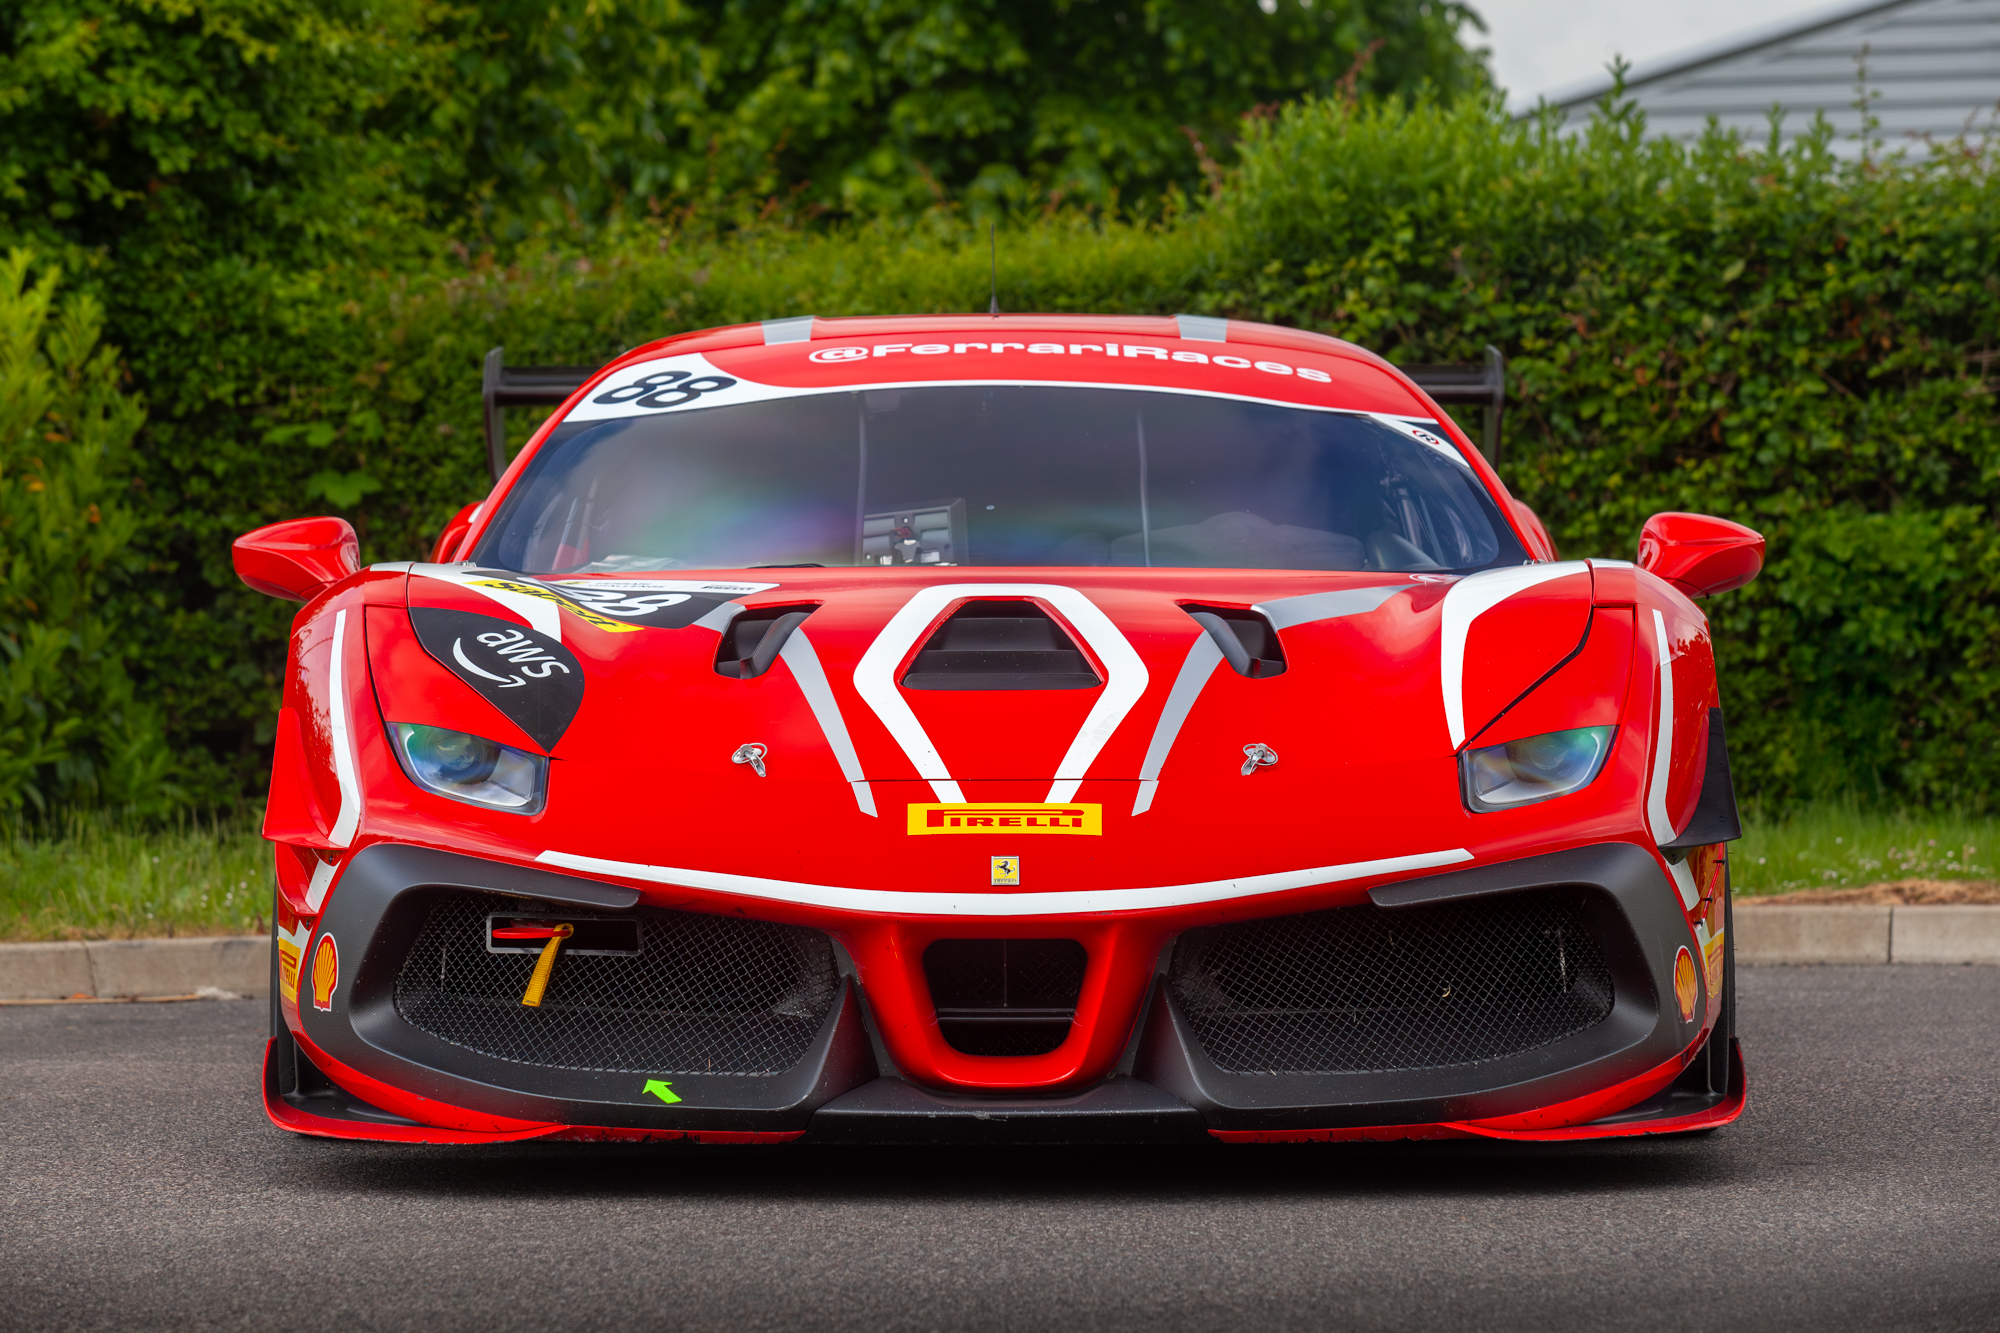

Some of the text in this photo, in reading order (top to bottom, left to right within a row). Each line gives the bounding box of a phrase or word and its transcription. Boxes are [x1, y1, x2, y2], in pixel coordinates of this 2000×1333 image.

[808, 342, 1333, 383] @FerrariRaces
[592, 370, 737, 408] 88
[476, 629, 570, 678] aws
[926, 809, 1085, 828] PIRELLI
